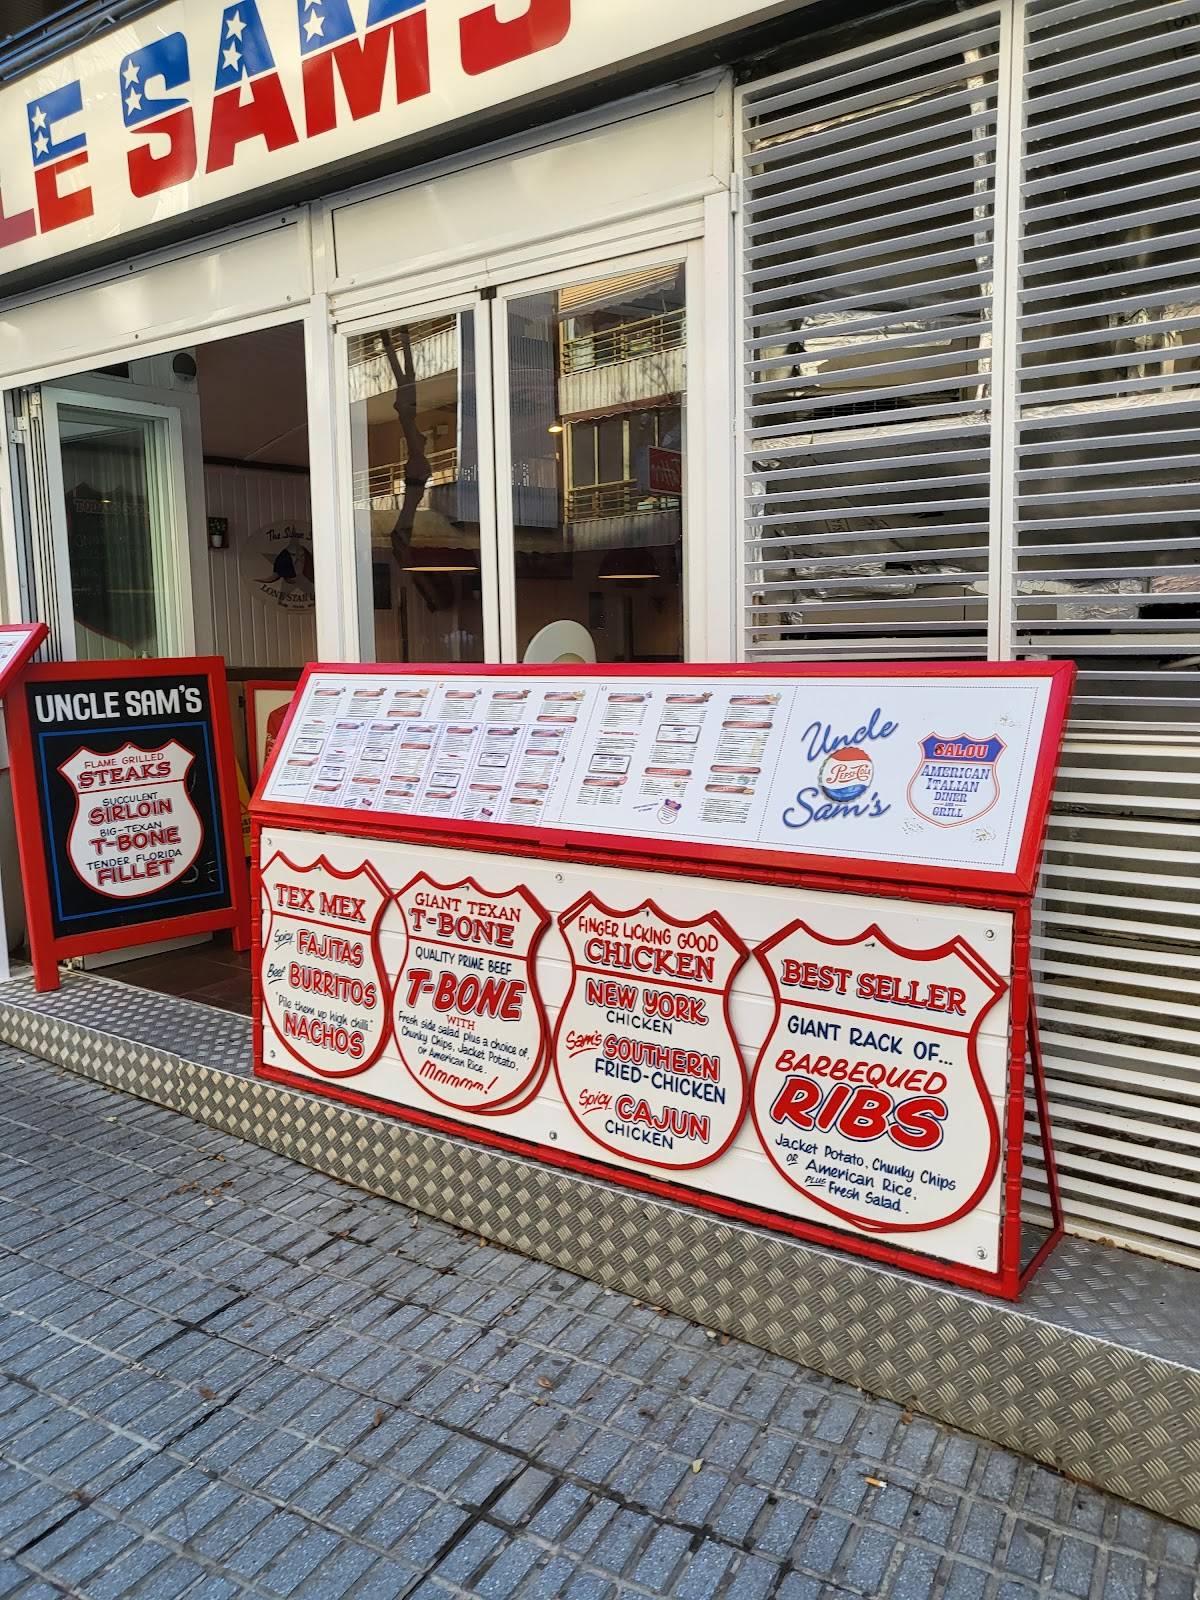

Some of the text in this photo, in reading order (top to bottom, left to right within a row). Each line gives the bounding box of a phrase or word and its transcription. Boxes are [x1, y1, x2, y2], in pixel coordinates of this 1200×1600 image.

[259, 584, 285, 601] LONE
[35, 685, 202, 723] UNCLE SAM'S
[801, 707, 900, 762] Uncle
[934, 743, 989, 758] SALOU
[77, 761, 171, 789] STEAKS
[84, 752, 164, 770] FLAME GRILLED
[921, 764, 991, 780] AMERICAN
[102, 791, 158, 807] SUCCULENT
[925, 778, 980, 793] ITALIAN
[934, 791, 967, 803] DINER
[88, 798, 172, 827] SIRLOIN
[782, 791, 891, 828] Sam's
[932, 806, 964, 818] GRILL
[89, 826, 181, 855] T-BONE
[100, 820, 162, 837] BIG-TEXAN
[86, 848, 182, 871] TENDER FLORIDA
[96, 859, 174, 886] FILLET
[274, 883, 367, 923] TEX MEX
[415, 892, 521, 922] GIANT TEXAN
[408, 907, 515, 948] T-BONE
[578, 915, 719, 952] FINGER LICKING GOOD
[274, 929, 364, 968] Spicy FAJITAS
[415, 946, 513, 975] QUALITY PRIME BEEF
[584, 937, 715, 983] CHICKEN
[267, 961, 378, 1009] Beef BURRITOS
[405, 968, 527, 1022] T-BONE
[585, 978, 709, 1027] NEW YORK
[781, 959, 968, 1016] BEST SELLER
[294, 1000, 316, 1016] them
[317, 1009, 327, 1021] up
[329, 1010, 348, 1027] high
[446, 1015, 476, 1030] WITH
[606, 1010, 673, 1035] CHICKEN
[282, 1010, 365, 1059] NACHOS
[399, 1010, 418, 1026] Fresh
[420, 1018, 436, 1032] side
[437, 1025, 460, 1039] salad
[463, 1031, 480, 1045] plus
[482, 1038, 489, 1047] a
[490, 1037, 517, 1055] choice
[401, 1025, 428, 1045] Chunky
[457, 1043, 485, 1060] Jacket
[787, 1015, 953, 1066] GIANT RACK OF...
[429, 1047, 465, 1068] American
[565, 1029, 720, 1083] Sam's SOUTHERN
[775, 1048, 947, 1095] BARBEQUED
[595, 1057, 726, 1105] FRIED-CHICKEN
[578, 1088, 711, 1144] Spicy CAJUN
[769, 1074, 949, 1151] RIBS
[604, 1119, 674, 1150] CHICKEN
[775, 1132, 819, 1155] Jacket
[872, 1157, 915, 1183] Chunky
[920, 1169, 957, 1191] Chips
[805, 1158, 875, 1188] American
[804, 1175, 909, 1214] PLUS Fresh Salad.
